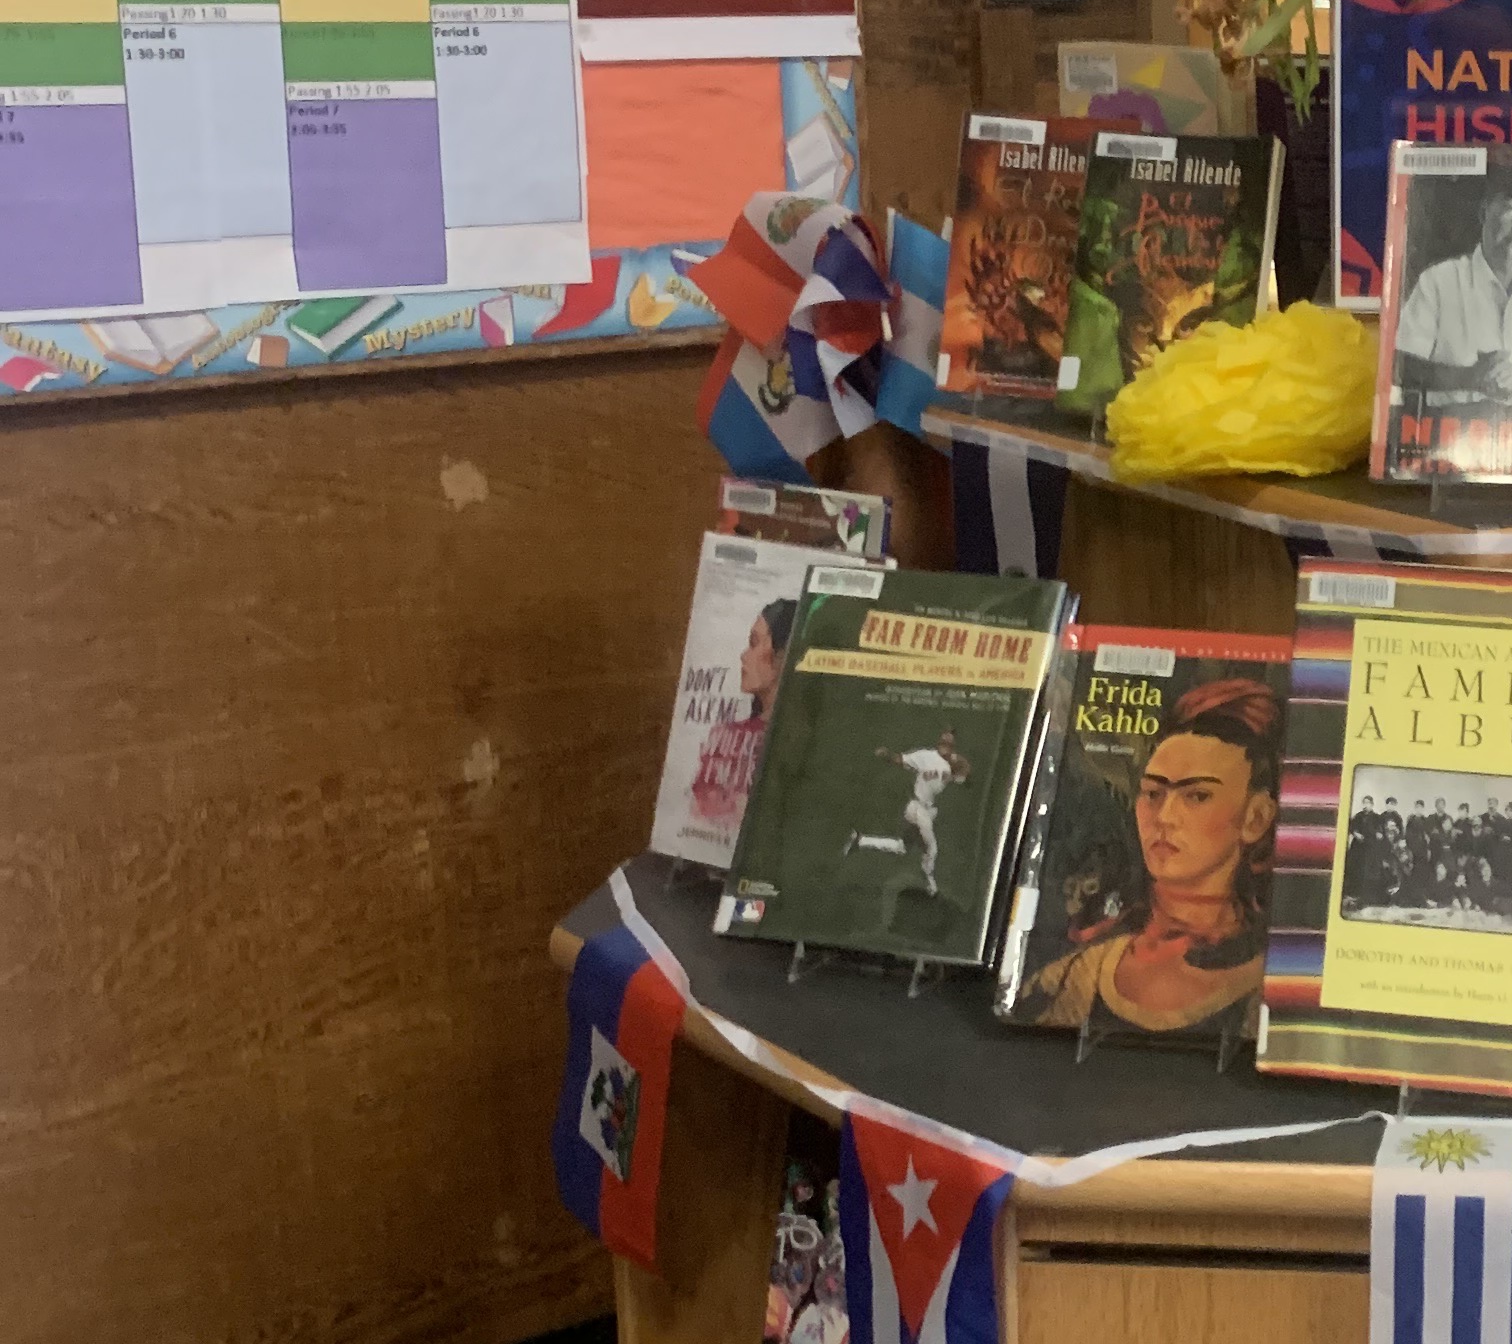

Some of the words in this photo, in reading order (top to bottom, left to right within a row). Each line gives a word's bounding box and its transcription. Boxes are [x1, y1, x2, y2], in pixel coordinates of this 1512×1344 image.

[123, 28, 165, 40] Period
[169, 29, 176, 40] 6
[434, 27, 469, 38] Period
[473, 27, 479, 38] 6
[290, 106, 329, 117] Period
[333, 105, 339, 116] 7
[1000, 142, 1044, 171] Isabel
[1131, 156, 1178, 182] Isabel
[1183, 156, 1241, 186] Allende
[362, 305, 475, 354] Mystery
[864, 616, 905, 647] FAR
[910, 622, 969, 655] FROM
[973, 631, 1032, 664] HOME
[1364, 636, 1402, 655] THE
[1409, 639, 1498, 662] MEXICAN
[685, 666, 730, 693] DON'T
[807, 656, 845, 669] LATINO
[849, 658, 906, 674] BASEBALL
[912, 663, 963, 678] PLAYERS
[978, 669, 1025, 681] AMERICA
[1088, 677, 1162, 707] Frida
[684, 695, 715, 724] ASK
[716, 696, 740, 723] ME
[1075, 705, 1160, 735] Kahlo
[1335, 947, 1404, 965] DOROTHY
[1409, 954, 1440, 968] AND
[1445, 957, 1504, 974] THOMAS
